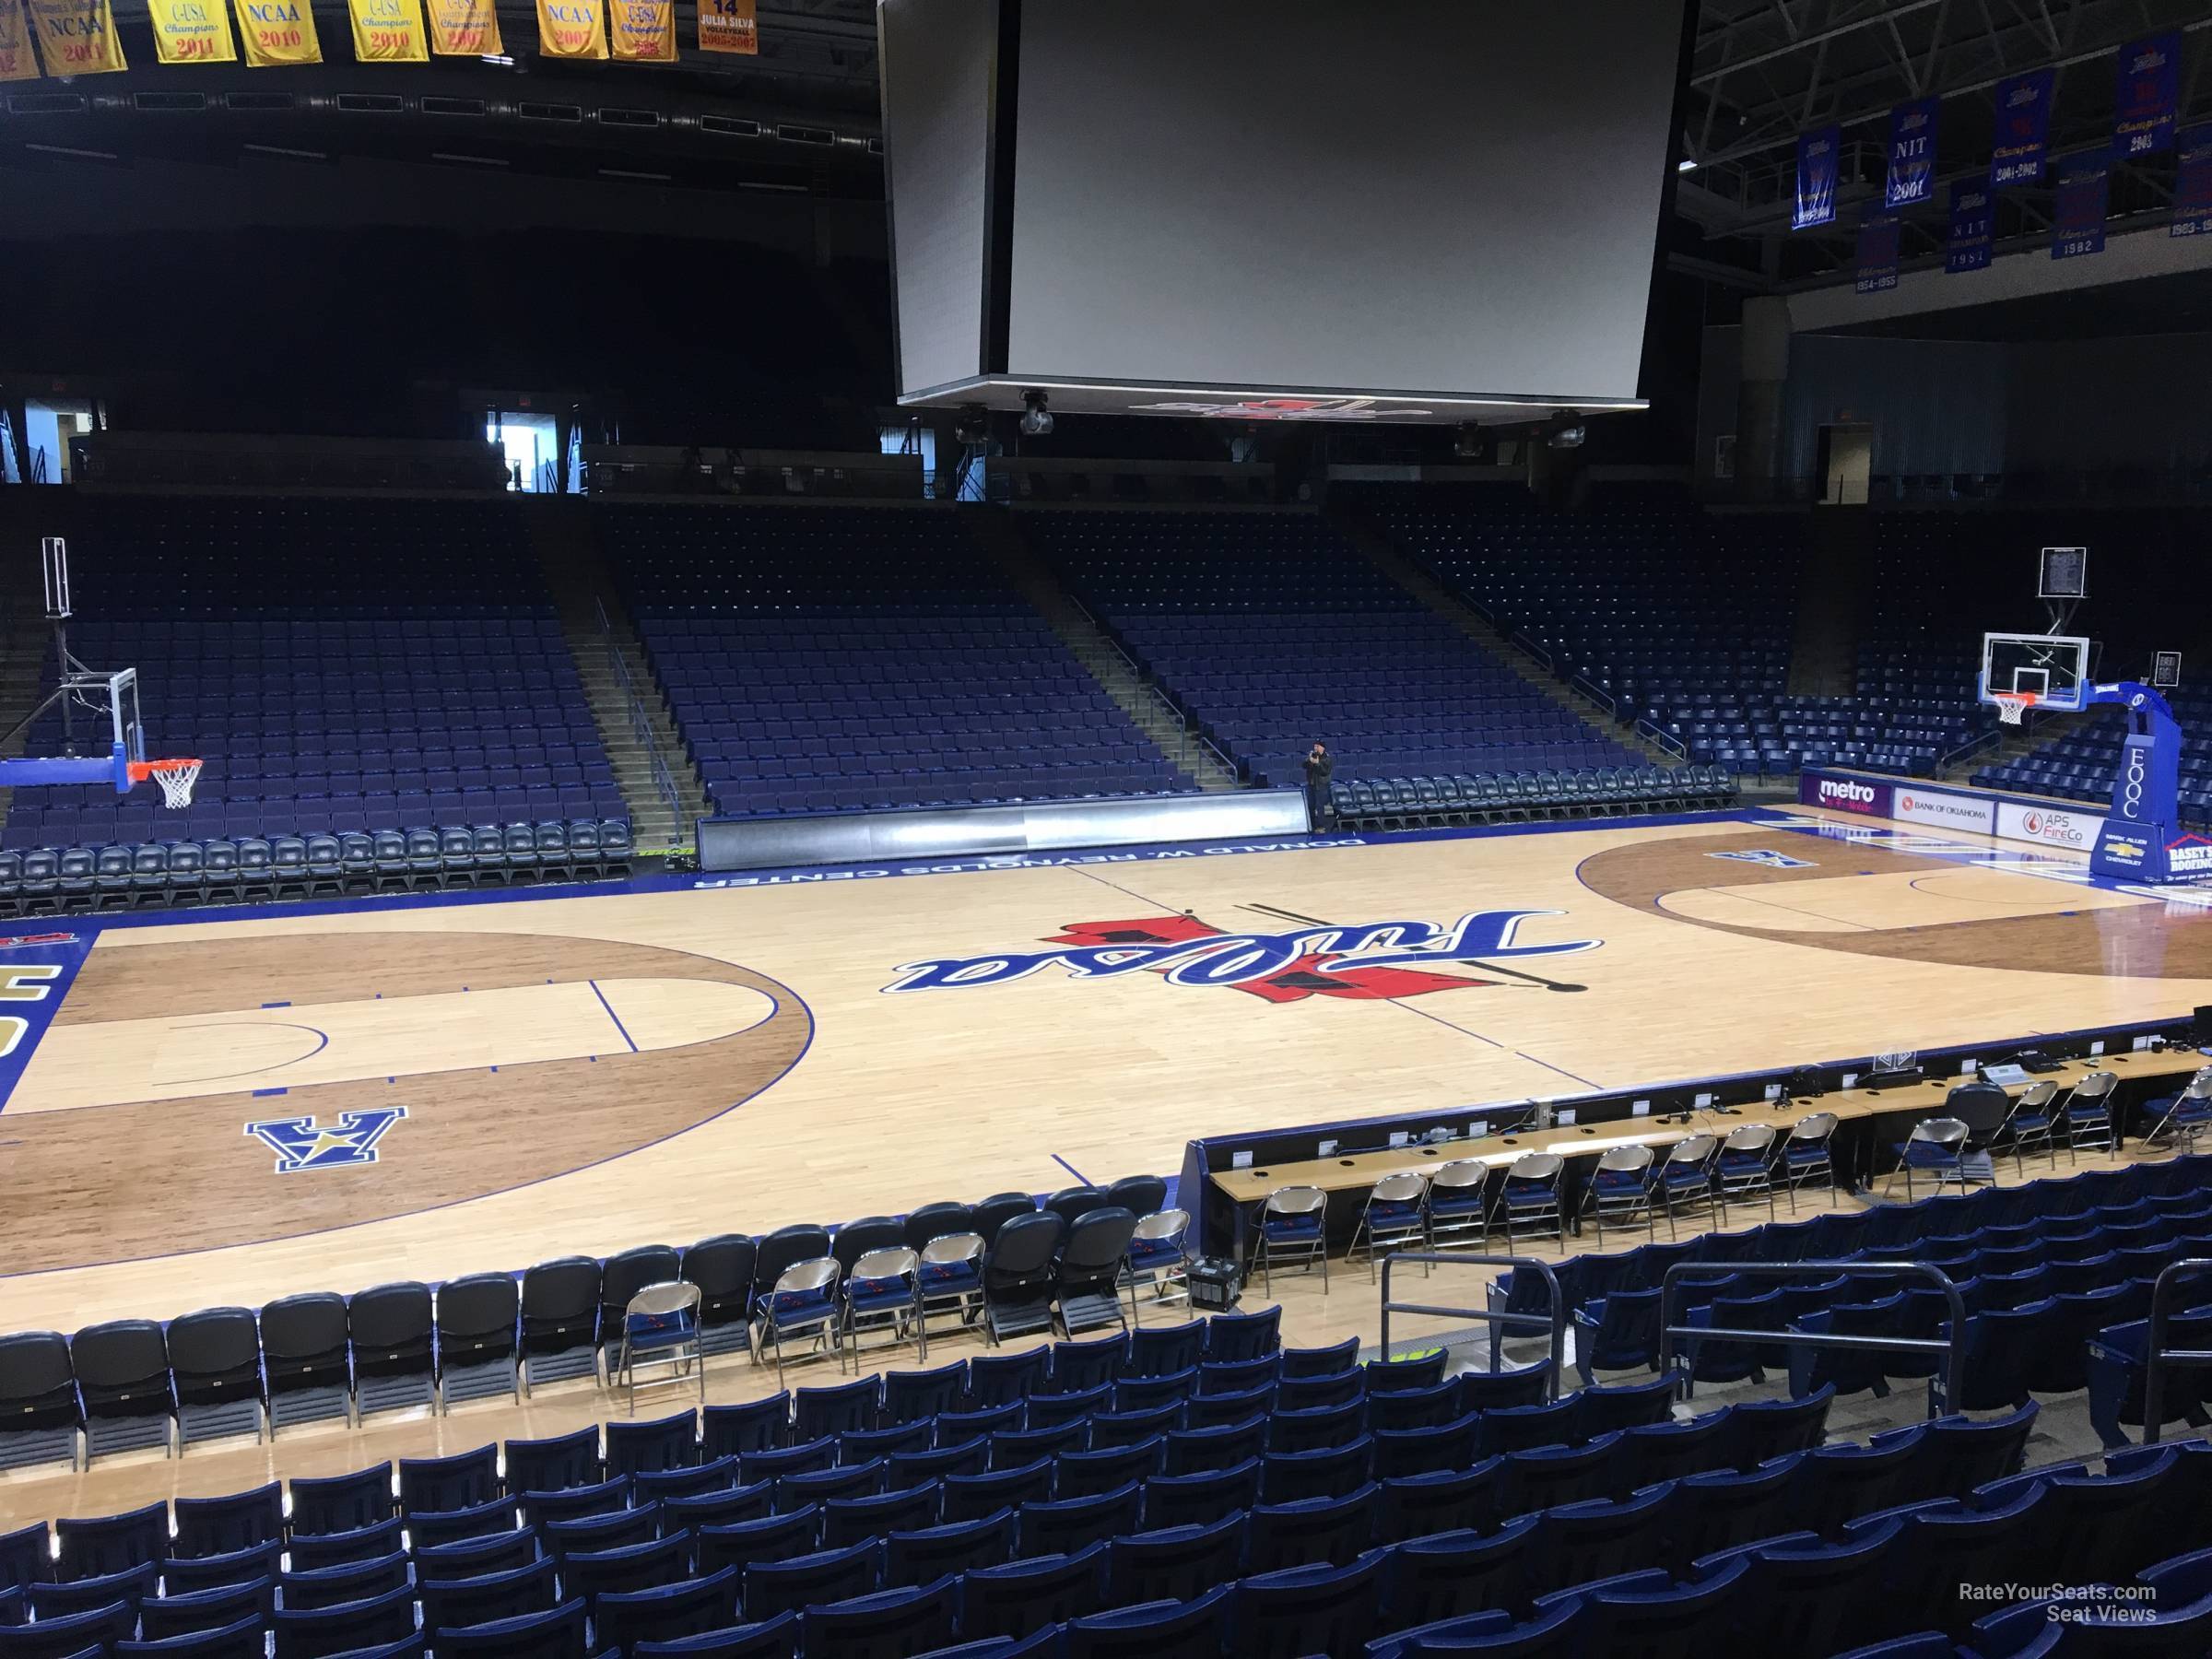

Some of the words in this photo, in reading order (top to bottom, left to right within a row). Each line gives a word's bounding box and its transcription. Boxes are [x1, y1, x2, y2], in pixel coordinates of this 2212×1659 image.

[172, 4, 206, 21] C-USA
[248, 4, 301, 22] NCAA
[547, 5, 594, 23] NCAA
[713, 0, 738, 15] 14
[48, 15, 104, 37] NCAA
[164, 23, 219, 34] Champions
[361, 17, 413, 29] Champions
[700, 14, 727, 27] JULIA
[729, 17, 755, 29] SILVA
[259, 29, 301, 48] 2010
[371, 31, 409, 48] 2010
[554, 29, 592, 46] 2007
[705, 26, 750, 36] VOLLEYBALL
[63, 43, 104, 63] 2011
[176, 37, 214, 55] 2011
[1895, 136, 1928, 159] NIT
[1893, 179, 1924, 202] 2001
[2064, 240, 2093, 254] 1982
[1818, 780, 1876, 803] metro
[1914, 801, 1934, 811] BANK
[1936, 804, 1945, 813] OF
[1946, 806, 1986, 819] OKLAHOMA
[2045, 814, 2070, 828] APS
[2043, 825, 2083, 841] FireCo
[2105, 833, 2125, 841] MARK
[2125, 837, 2148, 845] ALLEN
[1147, 850, 1197, 859] W.
[1202, 838, 1368, 855] DONALD
[900, 853, 1138, 876] REYNOLDS
[2105, 855, 2143, 866] CHEVROLET
[693, 869, 890, 889] CENTER
[879, 910, 1606, 994] Tulsa
